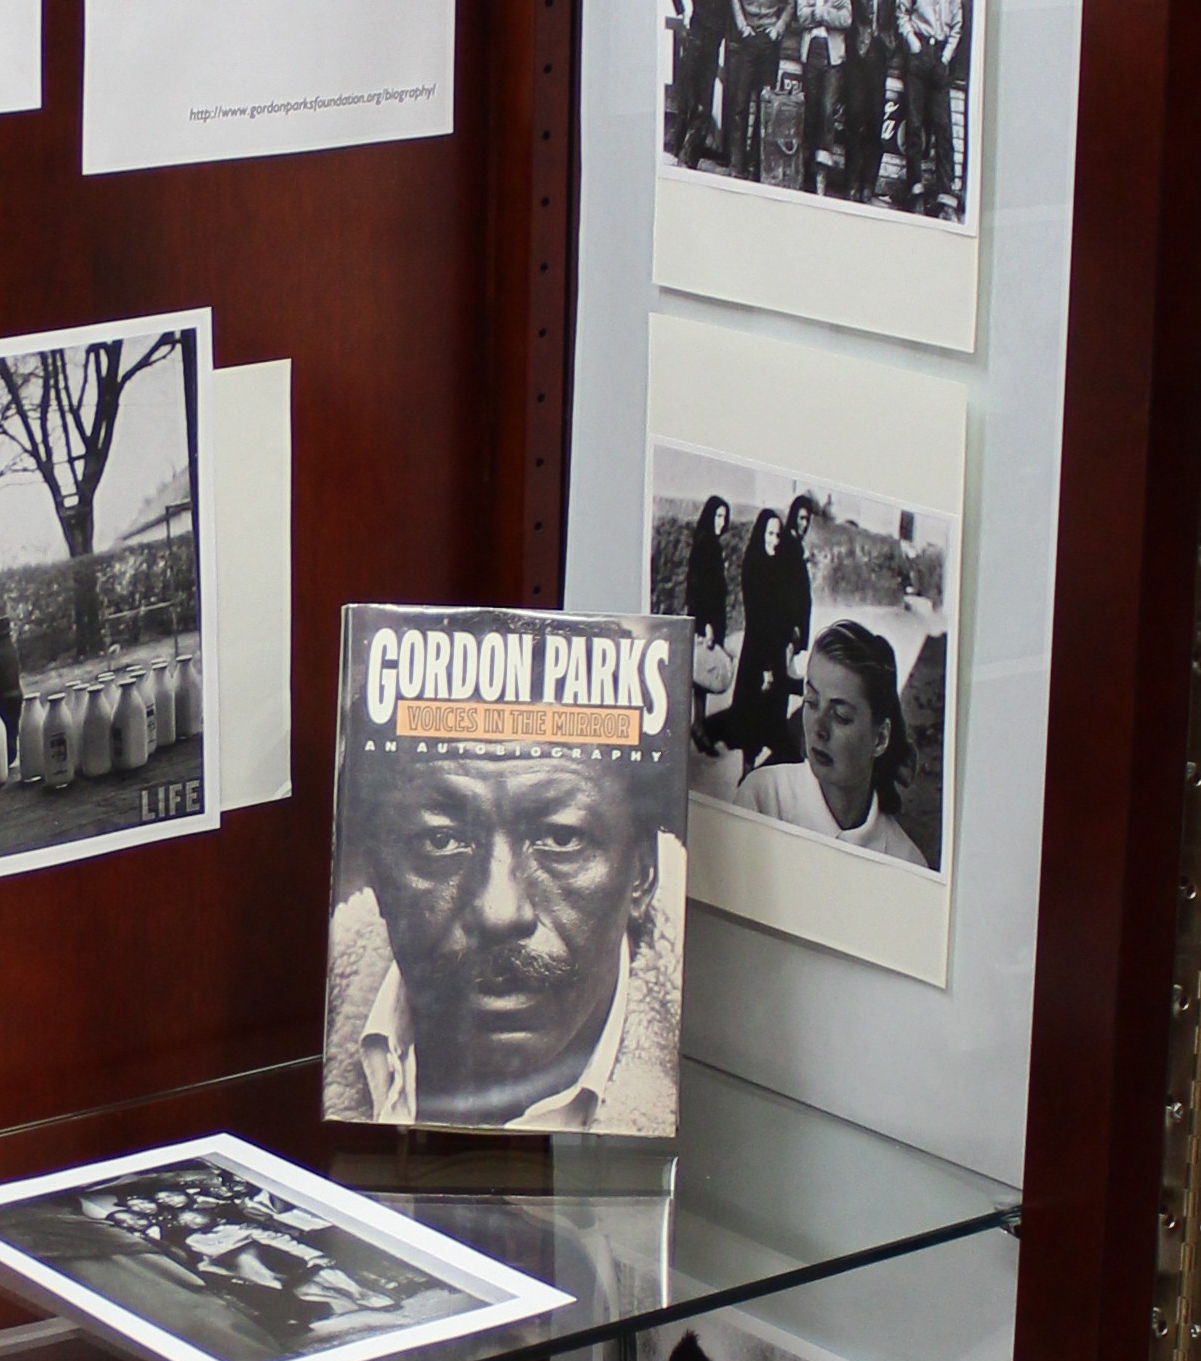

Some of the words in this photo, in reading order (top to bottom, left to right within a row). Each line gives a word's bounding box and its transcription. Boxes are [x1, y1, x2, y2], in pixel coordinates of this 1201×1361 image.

[366, 628, 534, 725] GORDON
[542, 633, 670, 735] PARKS
[407, 705, 478, 733] VOICES
[484, 708, 503, 733] IN
[509, 710, 546, 735] THE
[551, 712, 630, 738] MIRROR
[365, 740, 398, 752] AN
[416, 741, 663, 763] AUTOBIOGRAPHY
[140, 779, 200, 821] LIFE
